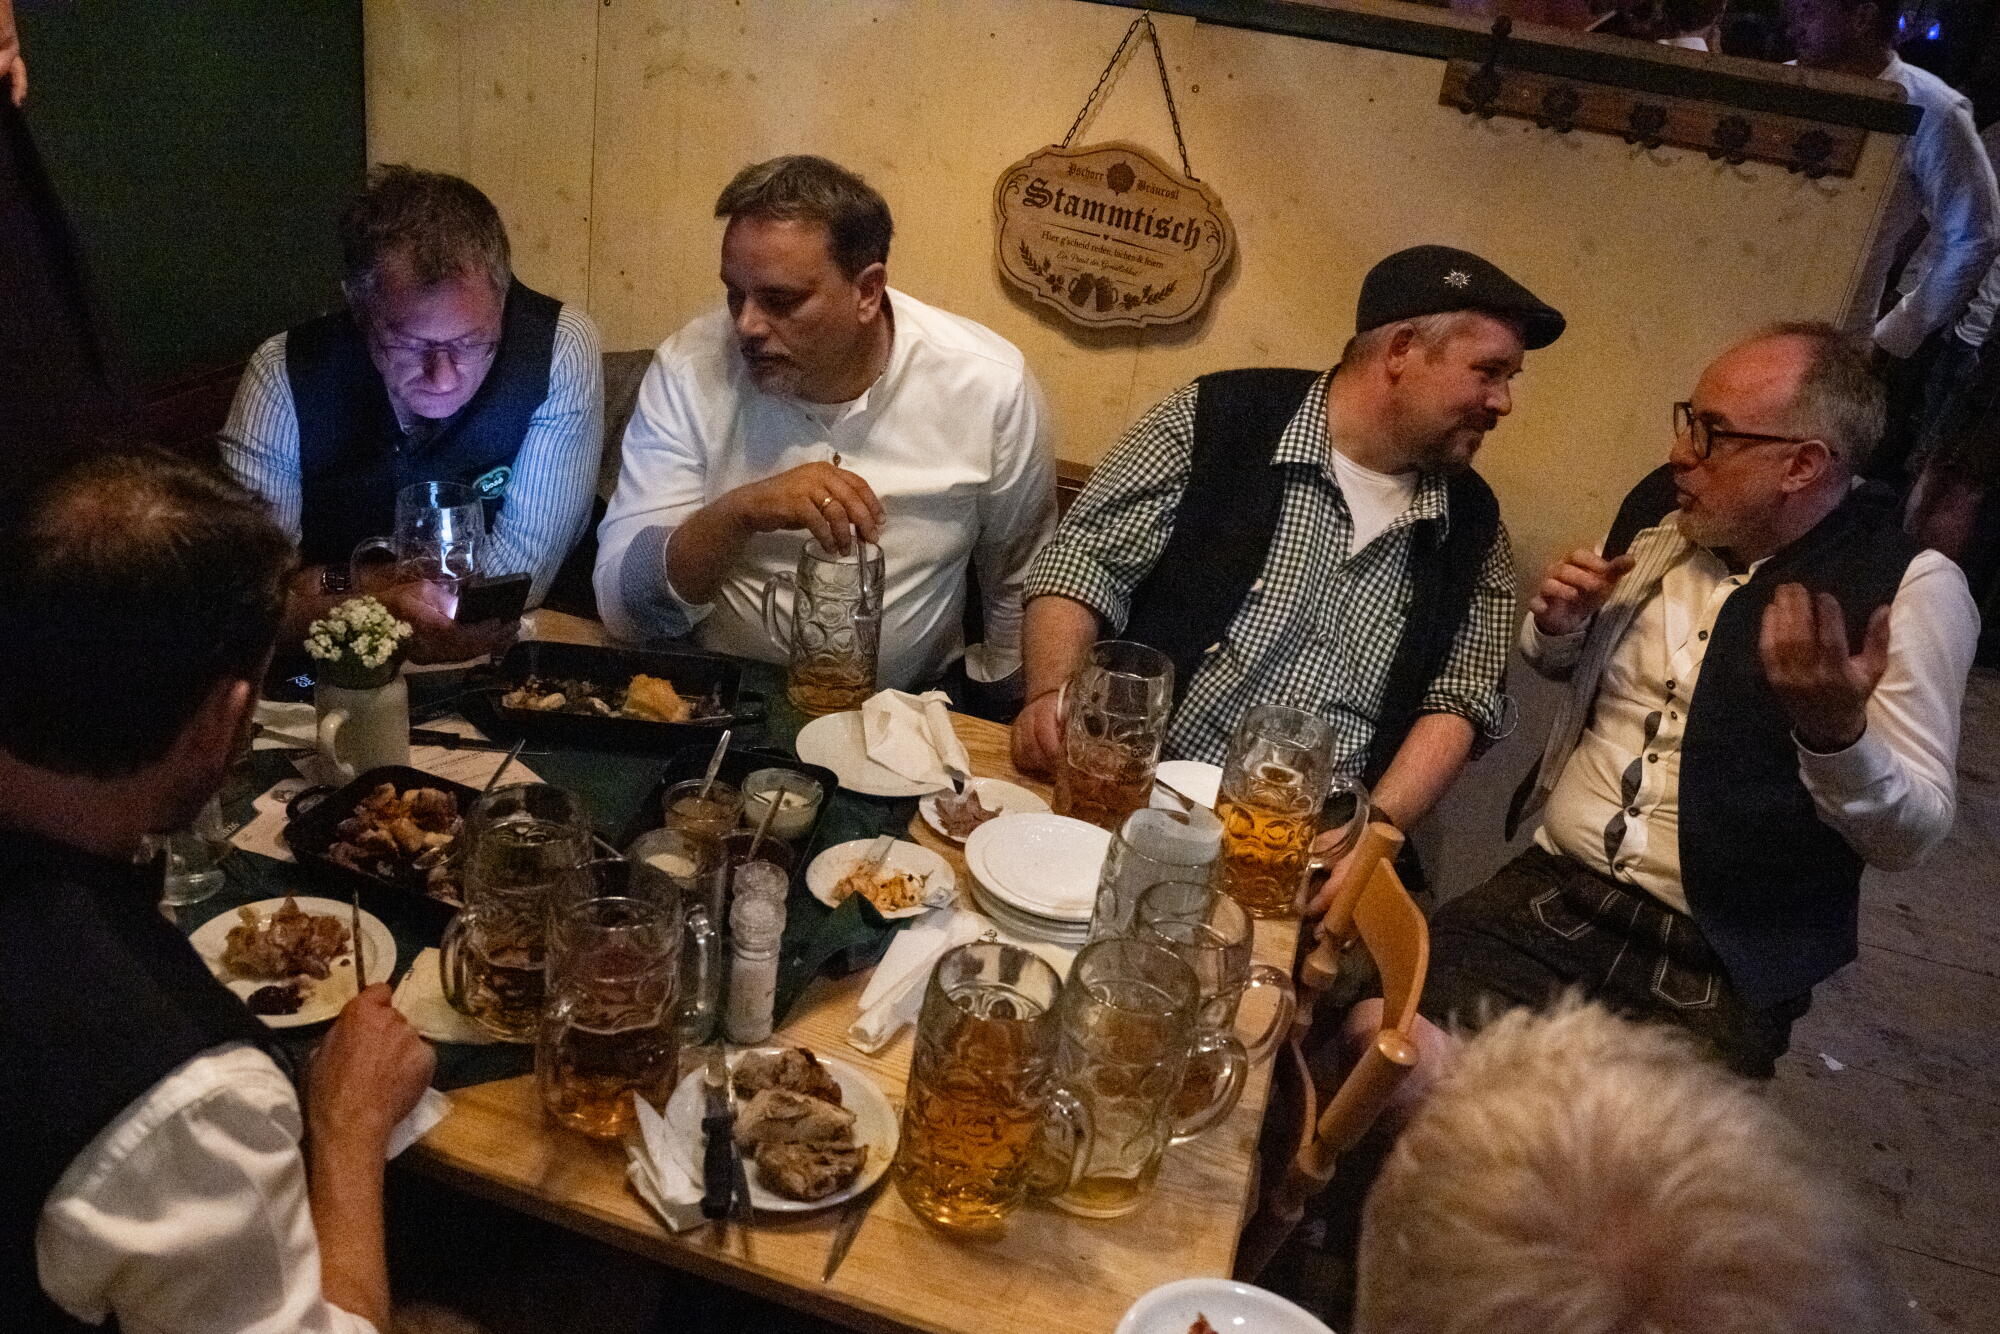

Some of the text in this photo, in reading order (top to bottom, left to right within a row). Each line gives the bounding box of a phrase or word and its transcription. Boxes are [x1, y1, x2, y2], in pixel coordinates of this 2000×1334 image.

[1067, 162, 1104, 181] Pschorr
[1022, 177, 1201, 252] Stammtisch
[1041, 230, 1059, 242] Hier
